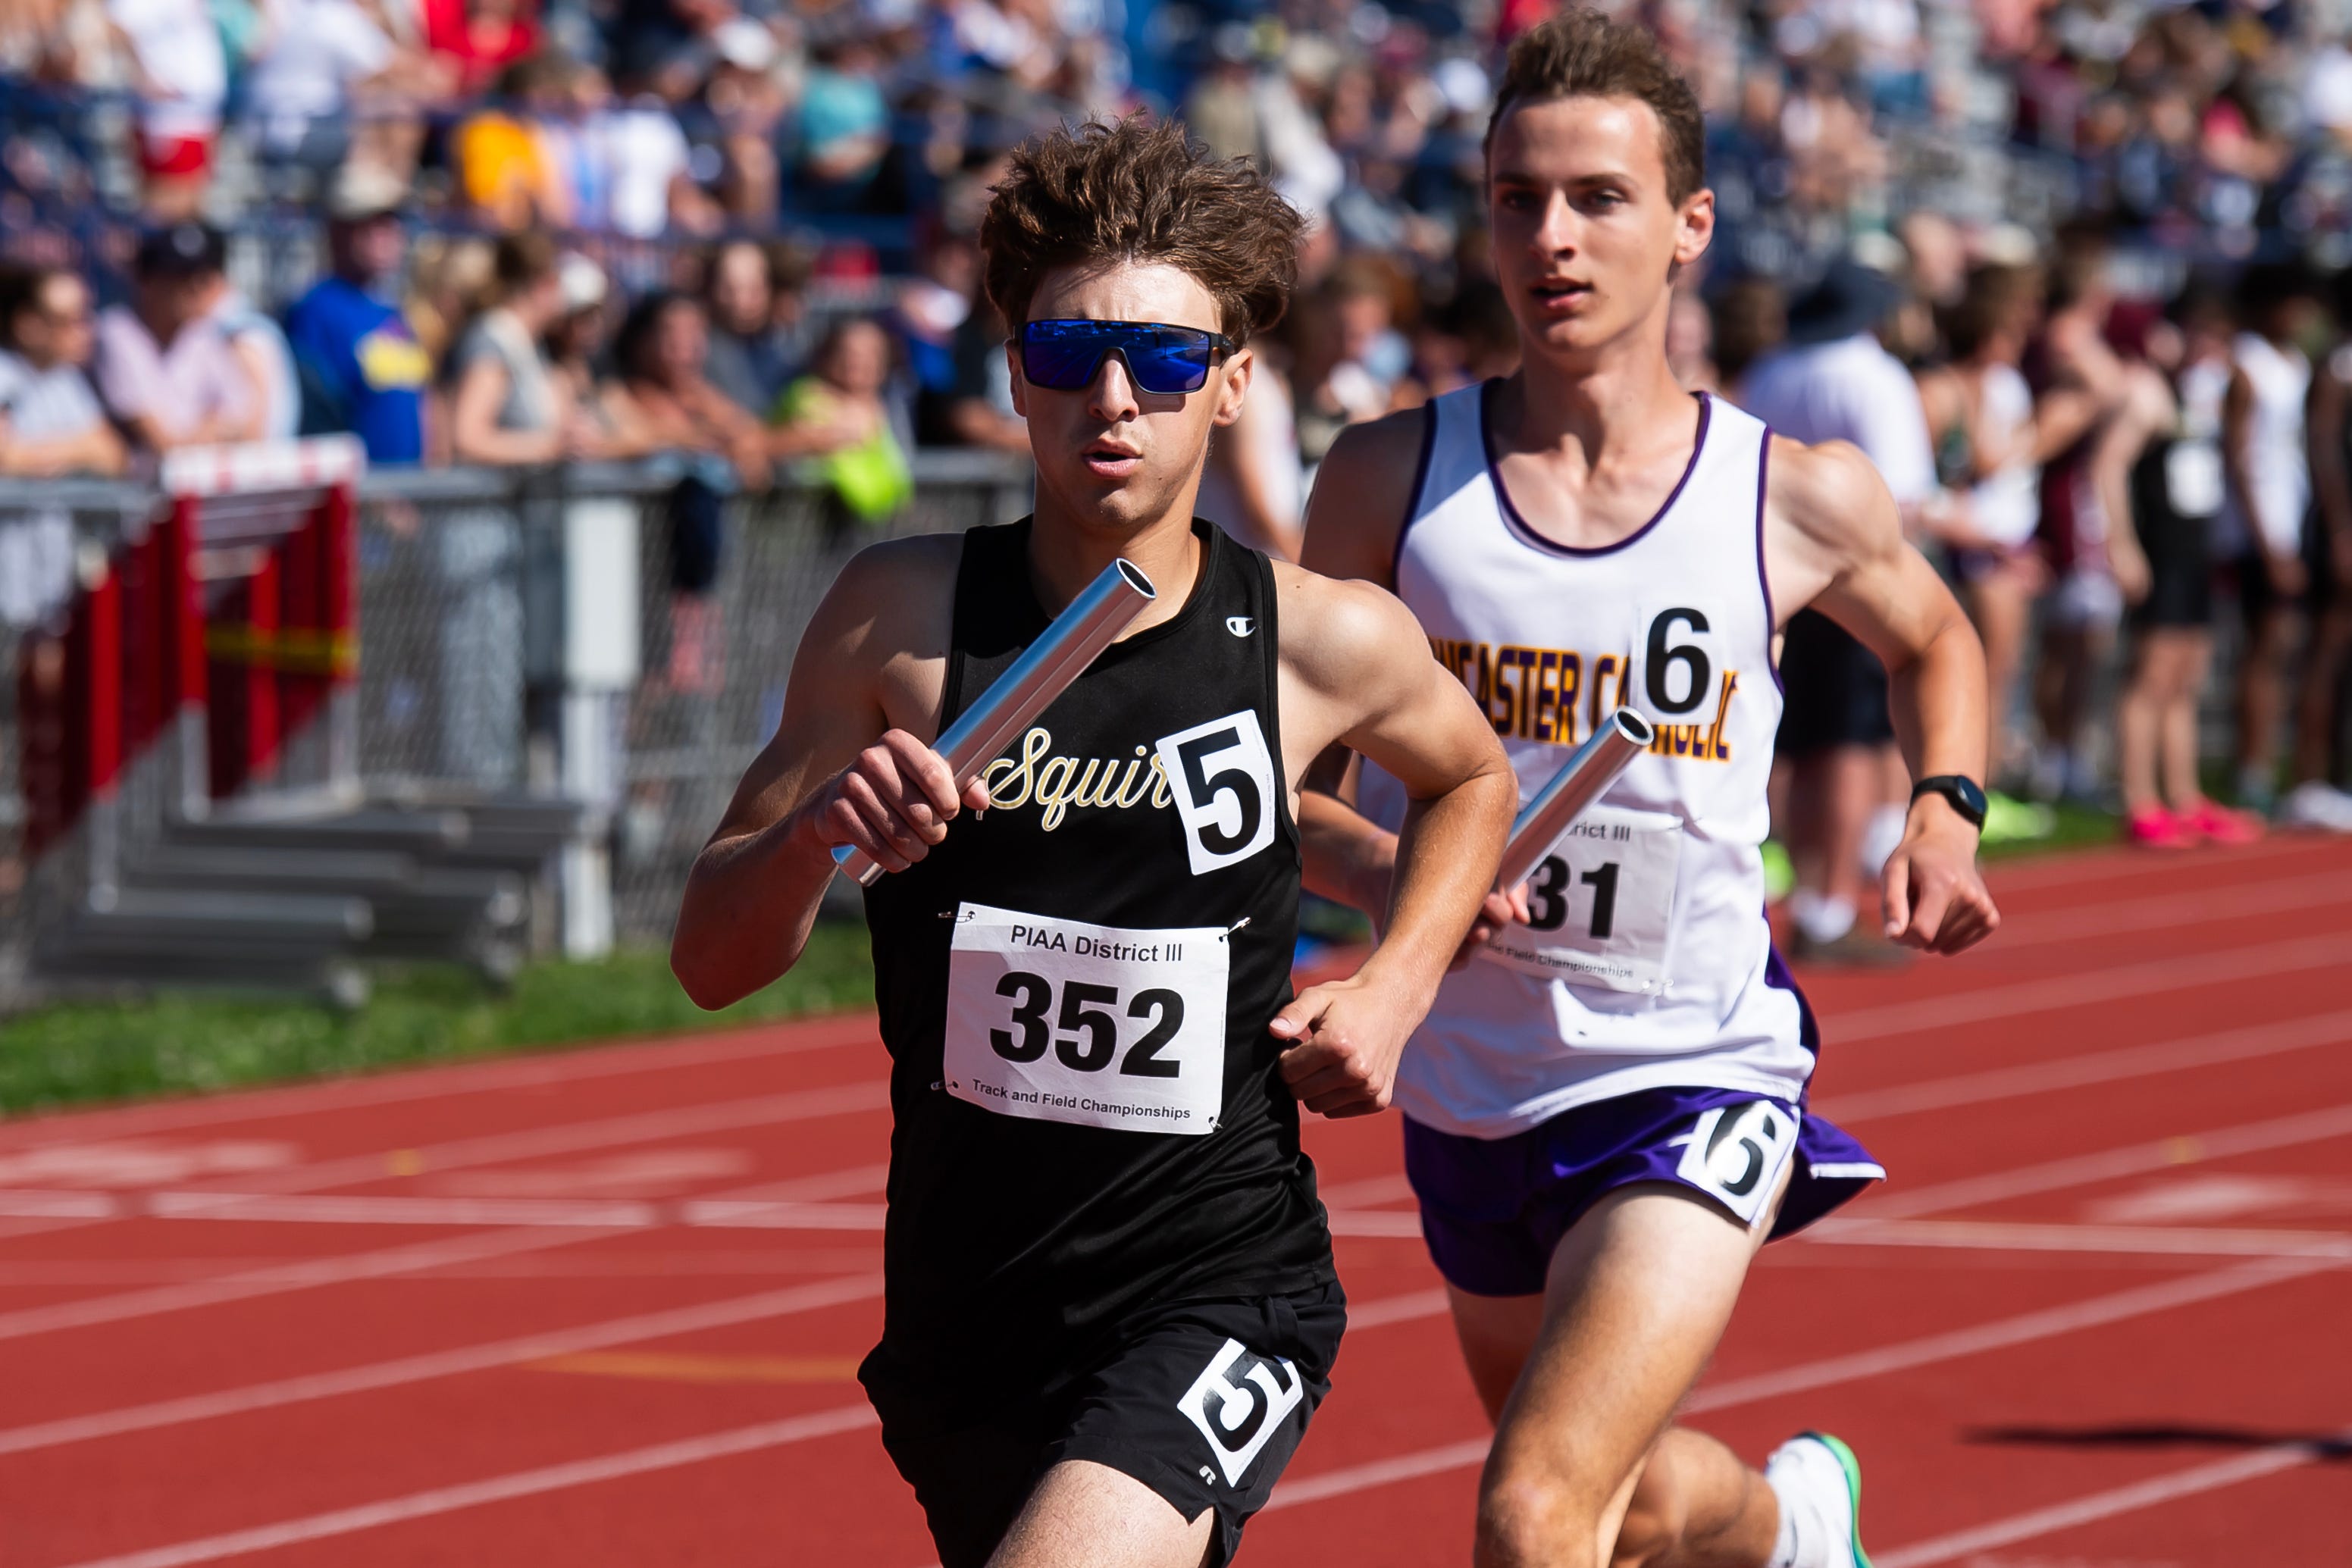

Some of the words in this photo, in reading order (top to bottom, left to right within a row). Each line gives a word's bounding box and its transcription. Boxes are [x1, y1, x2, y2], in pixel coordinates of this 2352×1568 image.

[1646, 607, 1711, 715] 6
[1176, 726, 1262, 856] 5
[1010, 925, 1067, 953] PIAA
[1075, 935, 1158, 962] District
[1165, 943, 1182, 962] III
[1537, 954, 1634, 978] Championships
[989, 971, 1185, 1078] 352
[972, 1078, 1008, 1100] Track
[1011, 1090, 1038, 1104] and
[1041, 1093, 1076, 1109] Field
[1081, 1098, 1191, 1120] Championships
[1705, 1100, 1776, 1197] 6
[1202, 1349, 1293, 1453] 5
